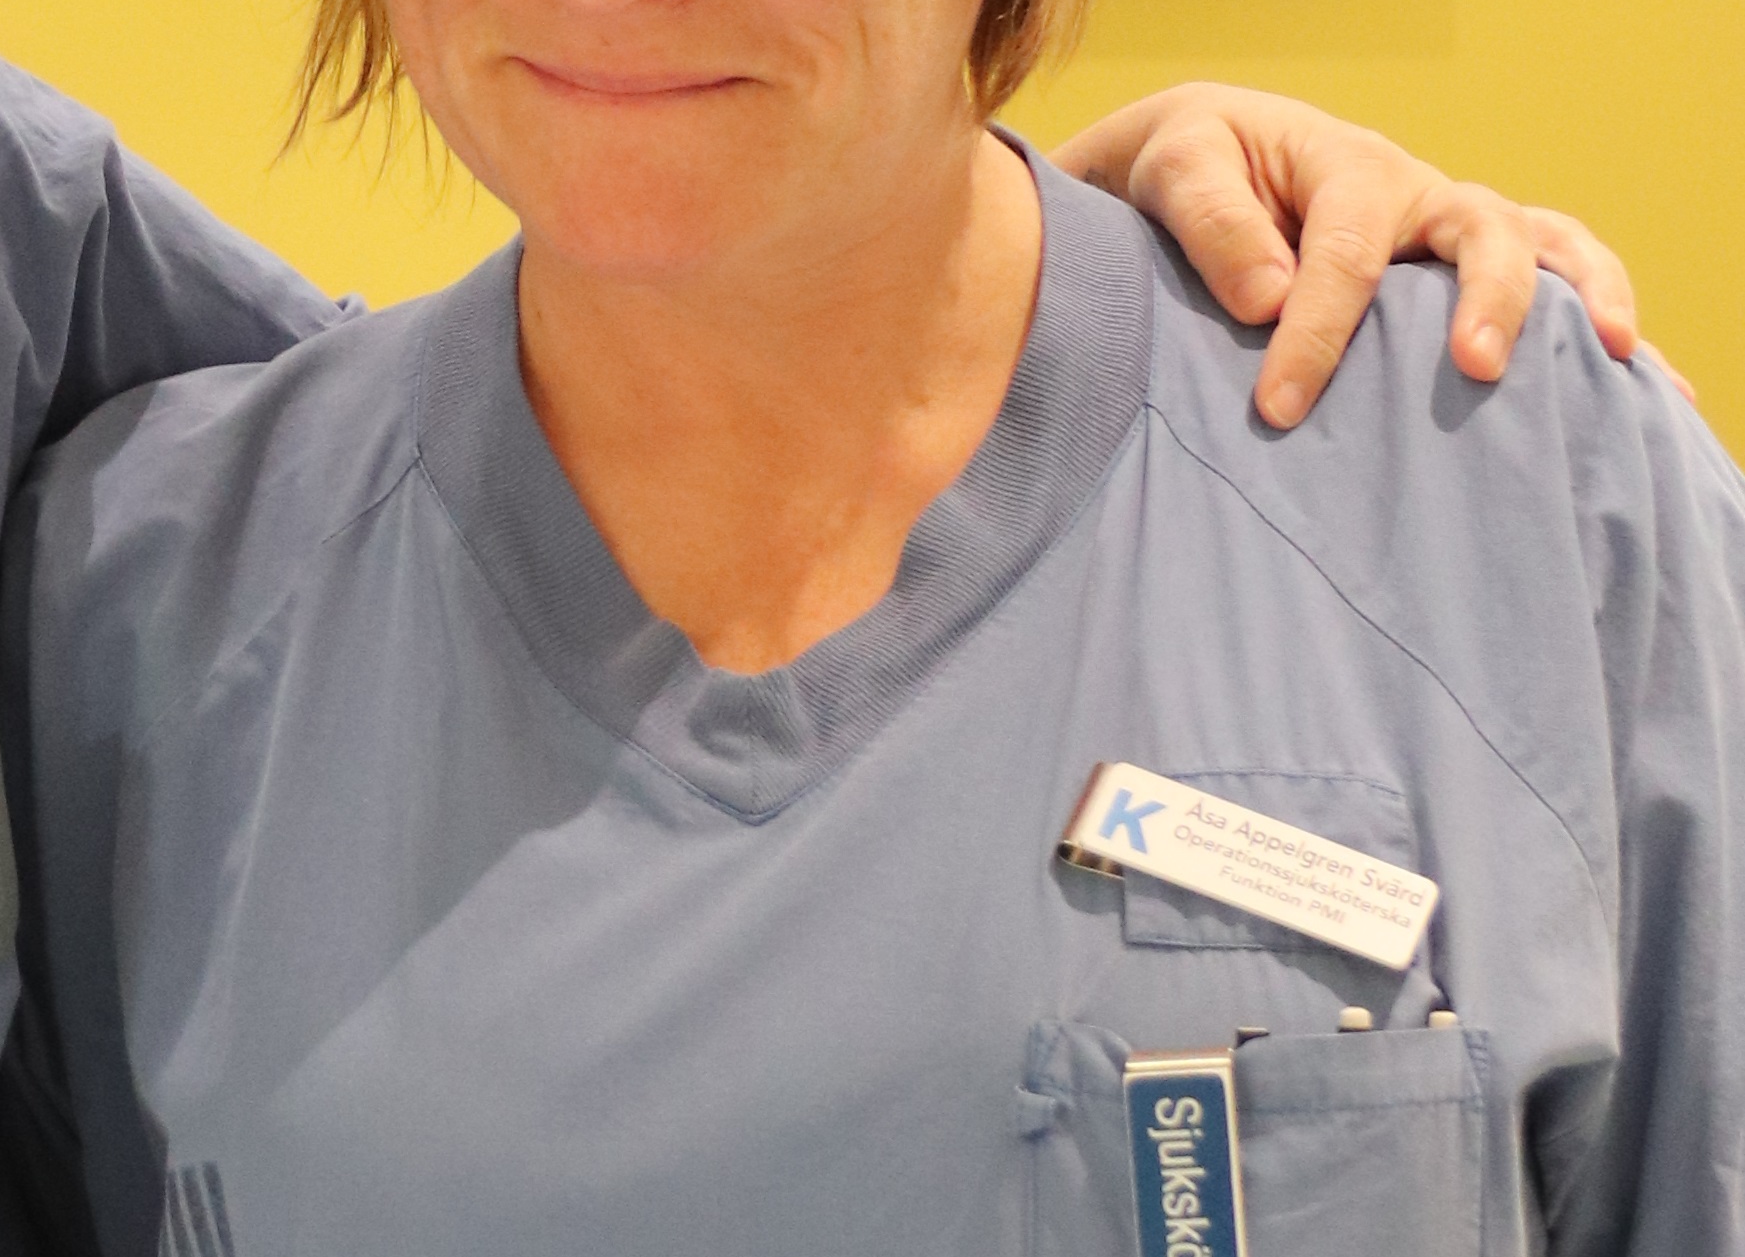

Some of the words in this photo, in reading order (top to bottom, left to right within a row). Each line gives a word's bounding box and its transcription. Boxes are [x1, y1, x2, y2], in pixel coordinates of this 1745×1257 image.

[1097, 787, 1168, 856] K
[1186, 797, 1227, 832] Åsa
[1236, 818, 1354, 880] Appelgren
[1359, 867, 1426, 908] Svärd
[1172, 824, 1413, 928] Operationssjuksköterska
[1218, 864, 1303, 907] Funktion
[1308, 898, 1349, 925] PMI
